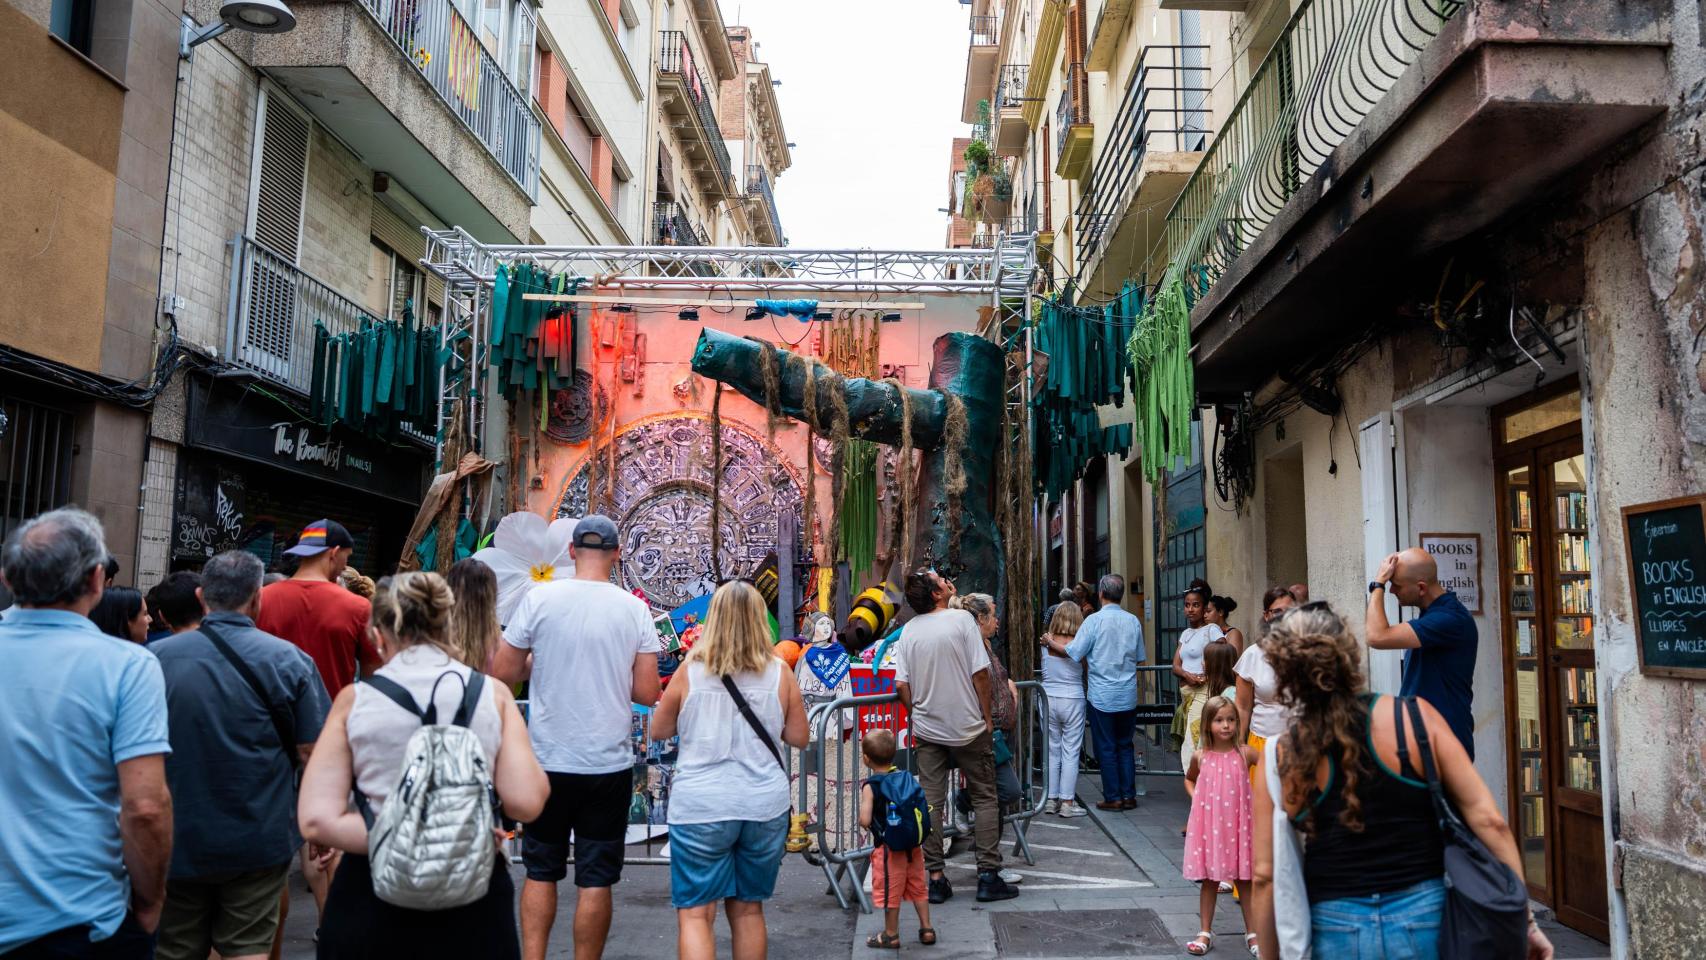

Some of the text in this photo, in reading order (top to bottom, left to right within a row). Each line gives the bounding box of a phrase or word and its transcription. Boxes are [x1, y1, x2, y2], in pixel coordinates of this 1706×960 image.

[270, 422, 294, 455] The
[1427, 543, 1473, 554] BOOKS
[1455, 559, 1467, 570] in
[1642, 559, 1694, 585] BOOKS
[1438, 576, 1474, 592] nglish
[1652, 592, 1662, 605] in
[1648, 619, 1687, 633] LLIBRES
